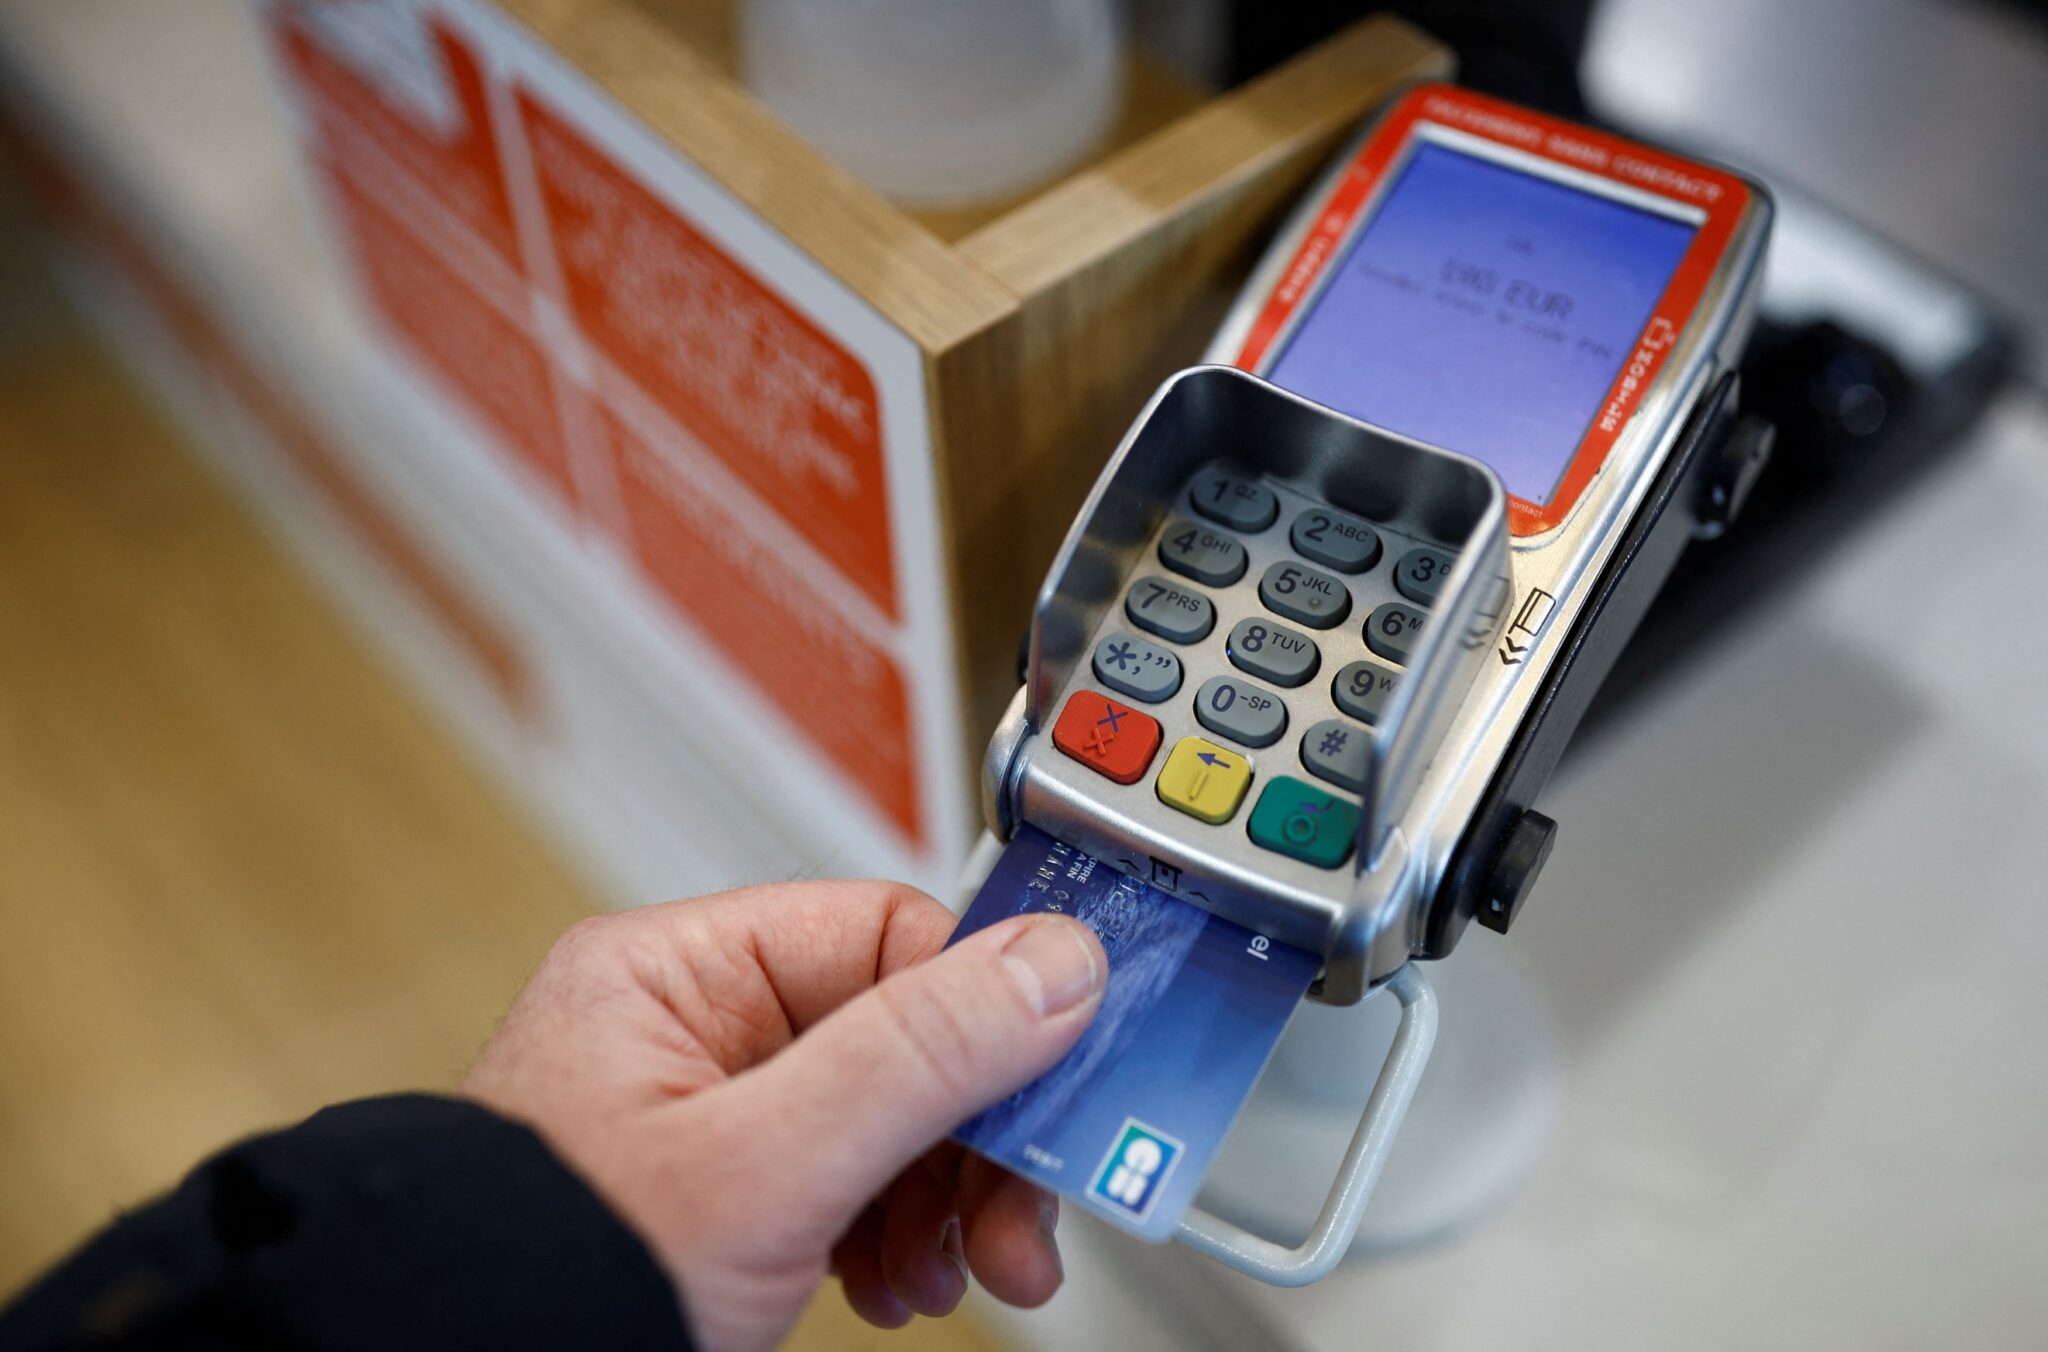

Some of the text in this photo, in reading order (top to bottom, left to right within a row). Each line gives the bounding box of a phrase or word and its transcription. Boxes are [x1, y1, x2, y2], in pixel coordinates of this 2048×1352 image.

[1213, 478, 1230, 503] 1
[1174, 529, 1232, 555] 4 GHI
[1304, 515, 1369, 544] 2 ABC
[1274, 567, 1333, 596] 5 JKL
[1411, 556, 1434, 583] 3
[1141, 581, 1201, 613] 7 PRS
[1382, 610, 1406, 637] 6
[1241, 624, 1306, 654] 8 TUV
[1349, 669, 1375, 697] 9
[1211, 684, 1272, 712] 0 -SP
[1066, 861, 1083, 880] FIN
[1104, 1136, 1163, 1208] CB
